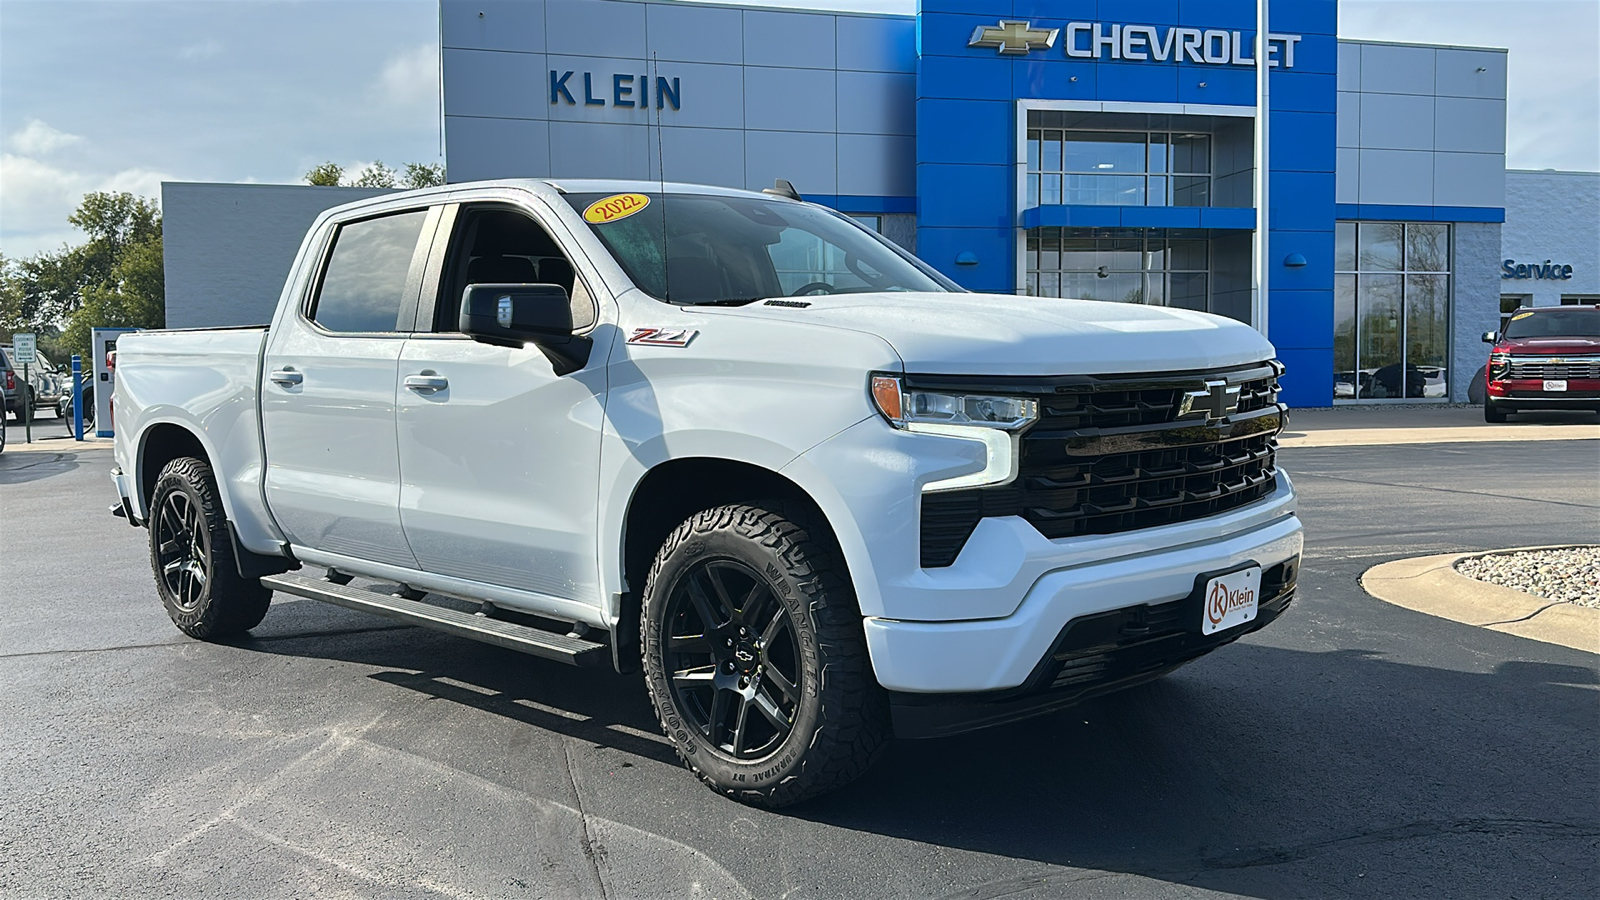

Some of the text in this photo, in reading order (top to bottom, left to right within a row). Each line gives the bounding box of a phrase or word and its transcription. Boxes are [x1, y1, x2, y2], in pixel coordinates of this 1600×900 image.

[1066, 21, 1302, 67] CHEVROLET
[550, 70, 680, 110] KLEIN
[595, 195, 641, 220] 2022
[1502, 259, 1573, 281] Service
[1229, 586, 1254, 608] Klein
[765, 561, 817, 697] WRANGLER
[649, 617, 698, 756] GOODYEAR
[731, 747, 798, 783] DURATRAC RT
